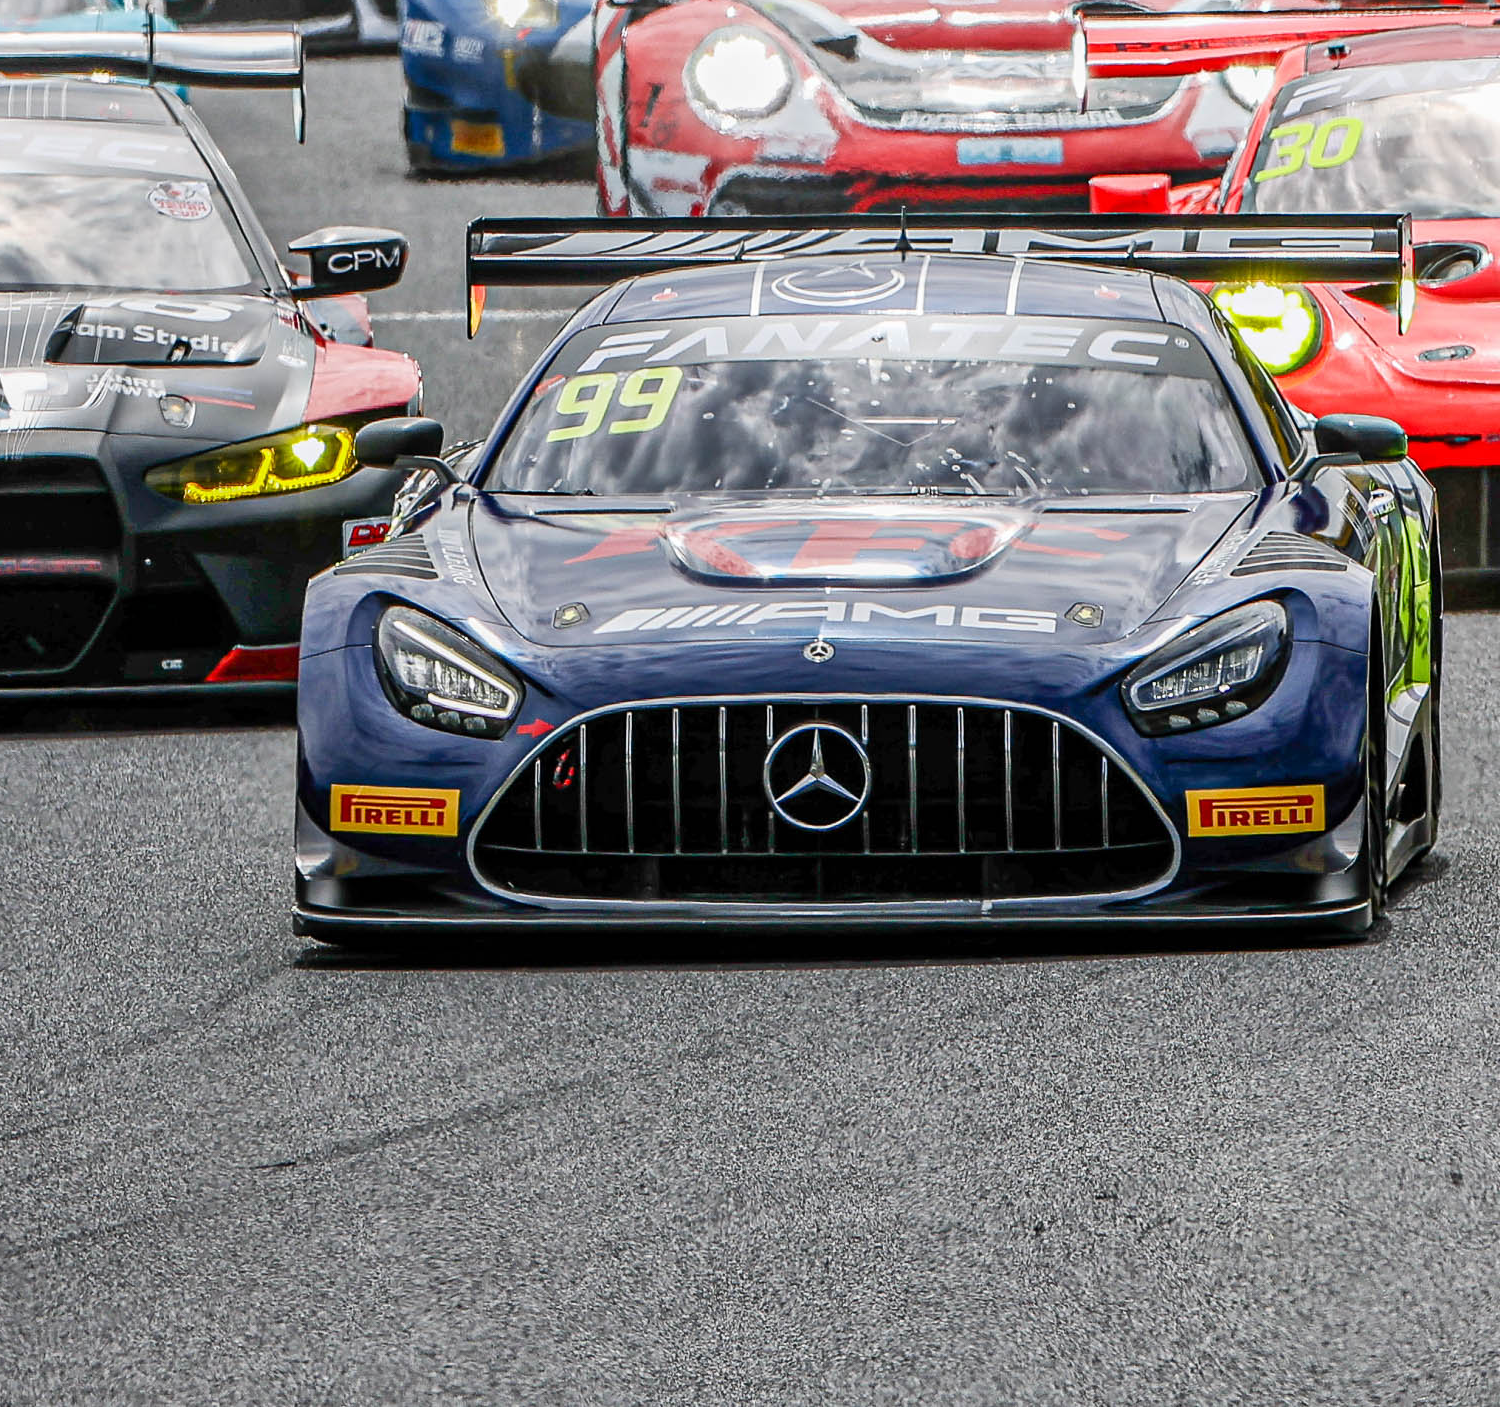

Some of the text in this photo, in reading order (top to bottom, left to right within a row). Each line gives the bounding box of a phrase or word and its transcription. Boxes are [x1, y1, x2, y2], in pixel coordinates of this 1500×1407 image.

[1254, 117, 1364, 184] 30
[326, 250, 402, 275] CPM
[576, 319, 1170, 373] FANATEC
[546, 365, 685, 443] 99
[730, 600, 1058, 634] AMG
[339, 793, 446, 828] PIRELLI
[1199, 793, 1316, 829] PIRELLI
